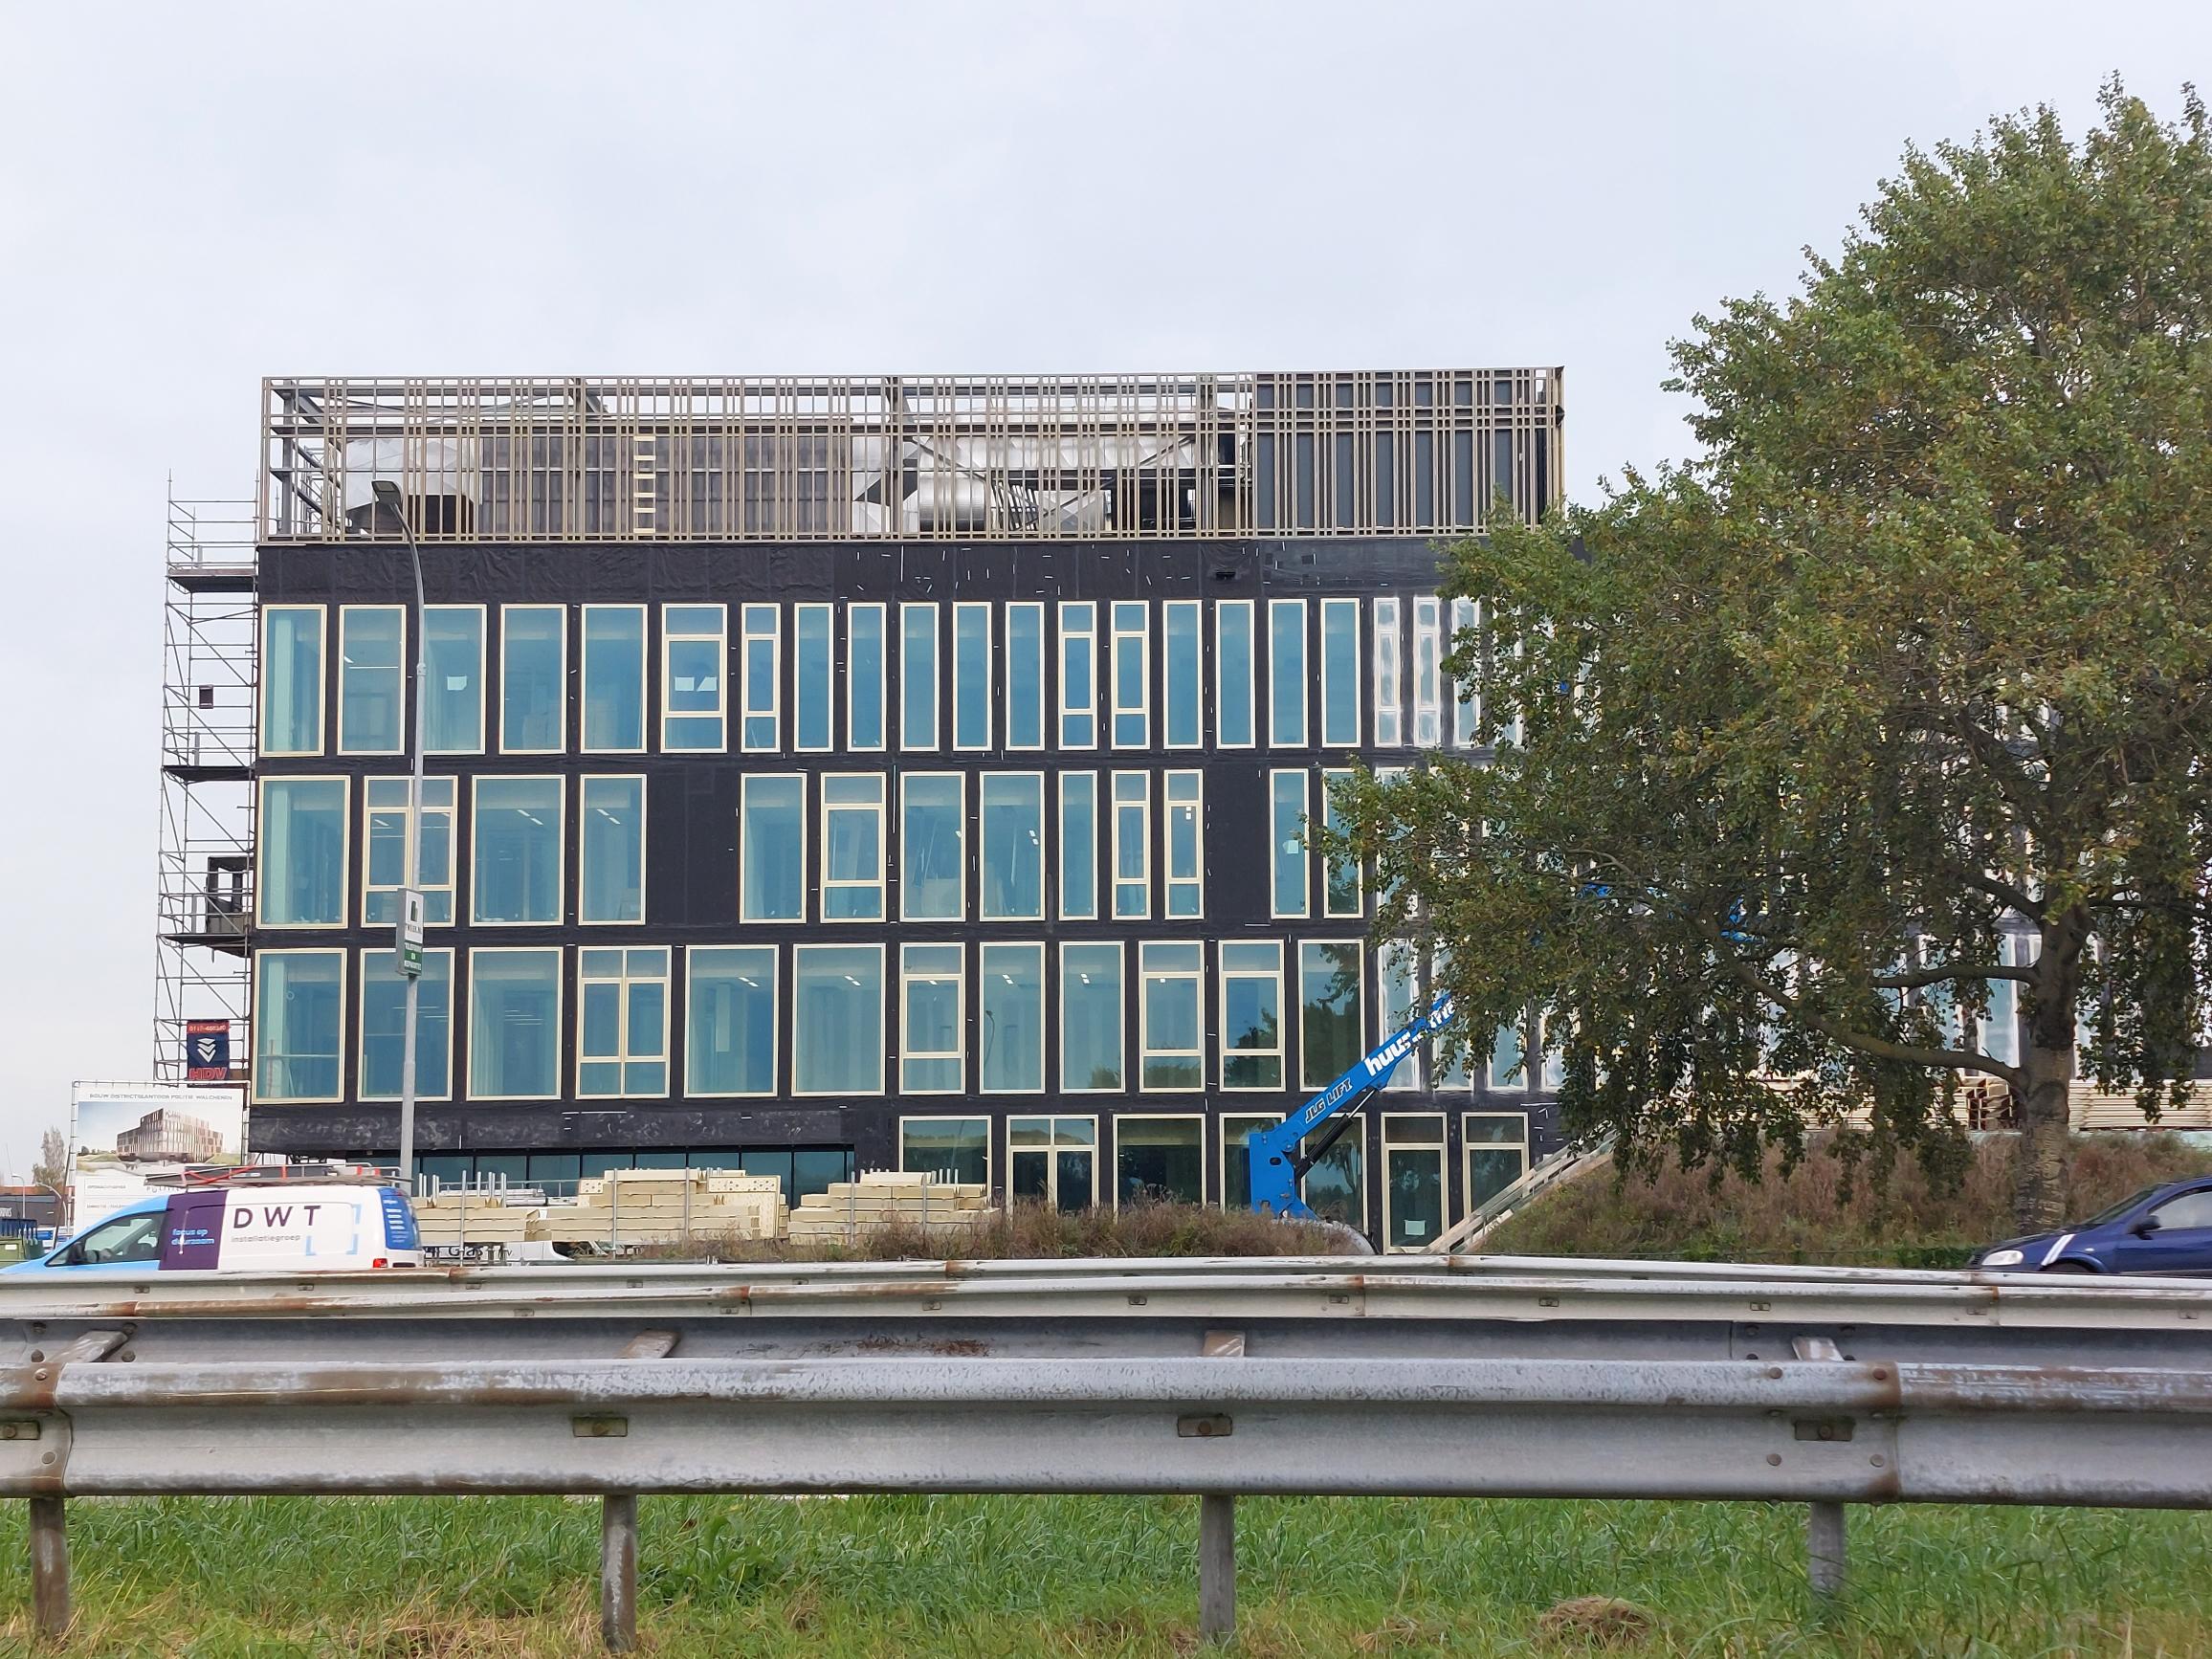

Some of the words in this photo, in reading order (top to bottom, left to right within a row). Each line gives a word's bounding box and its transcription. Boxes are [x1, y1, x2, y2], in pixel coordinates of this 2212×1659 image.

[188, 1067, 228, 1080] HDV
[1305, 1097, 1326, 1123] JLG
[1327, 1077, 1353, 1107] LIFT
[233, 1206, 321, 1228] DWT
